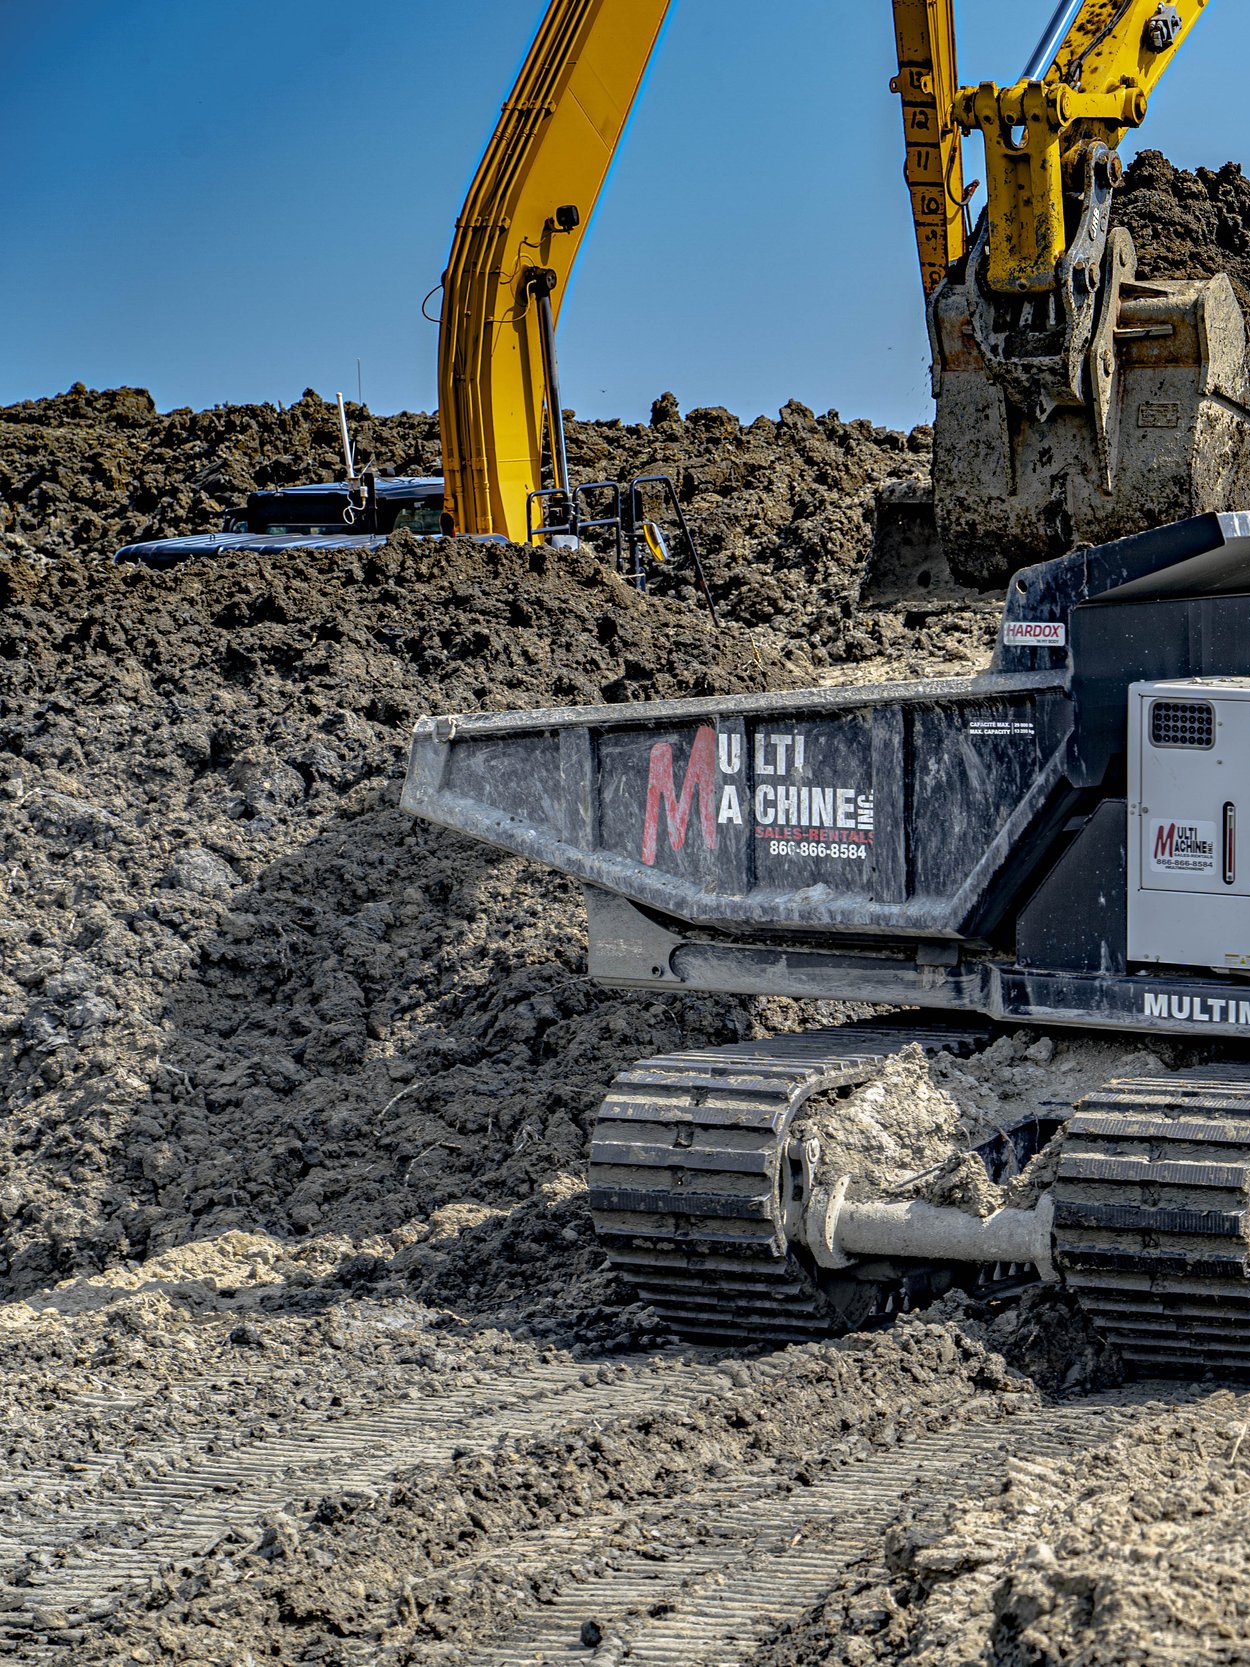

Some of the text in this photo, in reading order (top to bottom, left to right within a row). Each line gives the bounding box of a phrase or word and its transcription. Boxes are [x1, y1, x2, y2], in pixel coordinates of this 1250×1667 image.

[911, 109, 930, 131] 12
[916, 149, 930, 171] 11
[921, 194, 940, 215] 10
[856, 789, 874, 830] INC.
[769, 840, 867, 860] 866-866-8584
[1156, 859, 1214, 868] 866-866-8584
